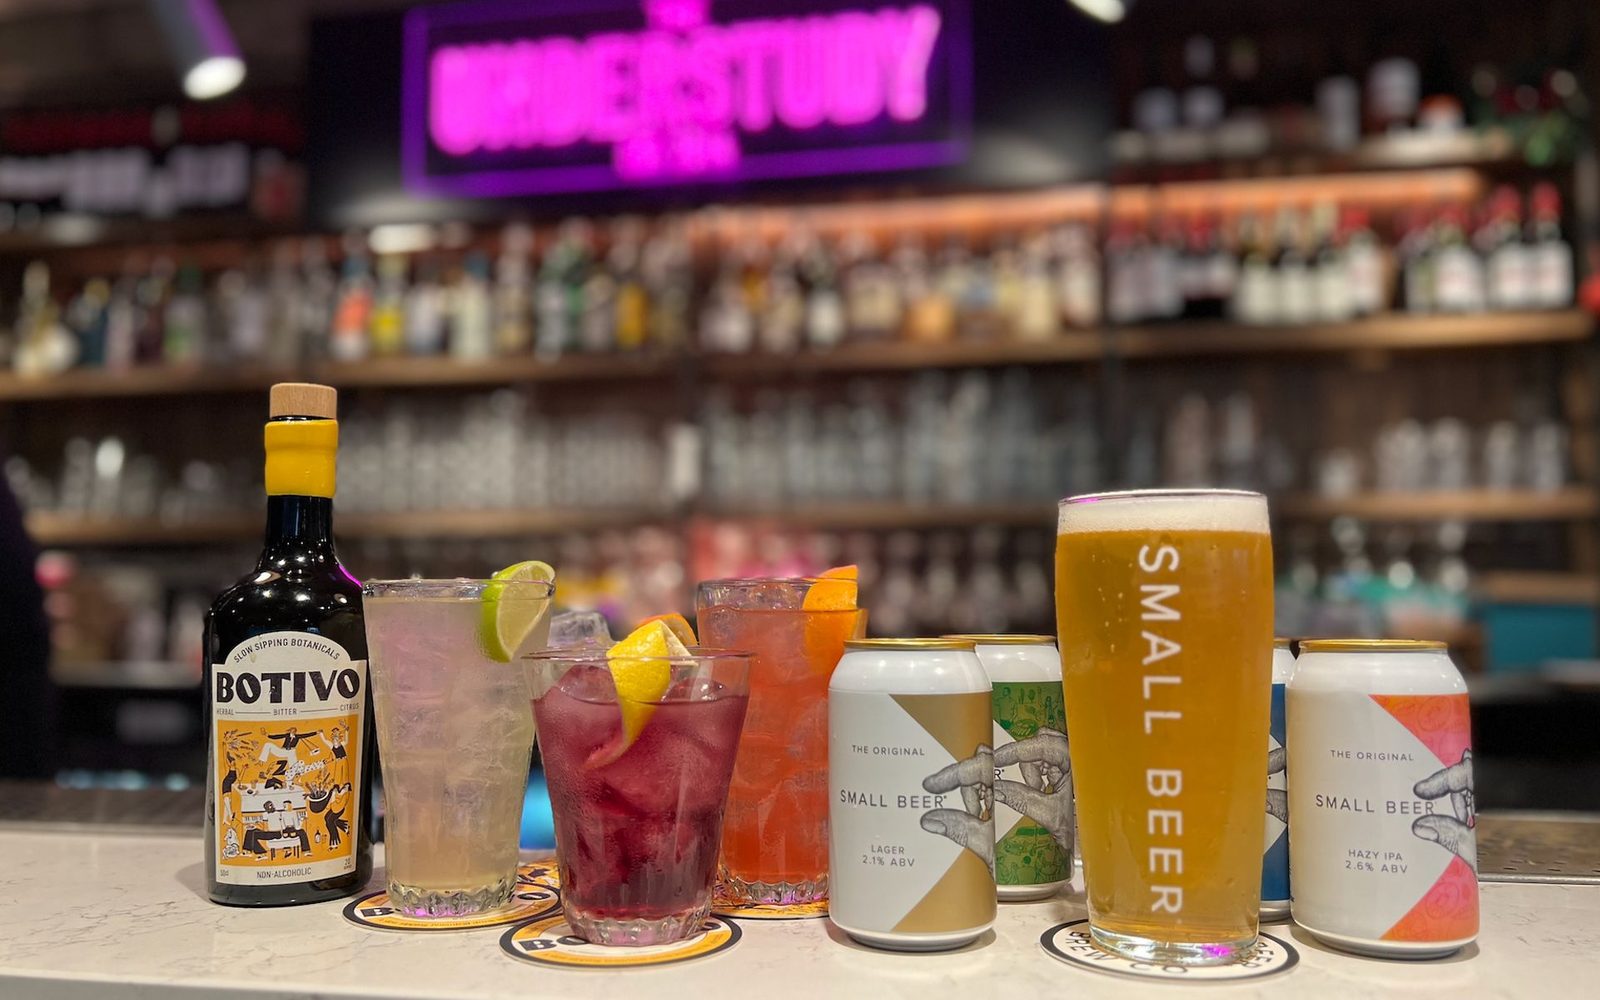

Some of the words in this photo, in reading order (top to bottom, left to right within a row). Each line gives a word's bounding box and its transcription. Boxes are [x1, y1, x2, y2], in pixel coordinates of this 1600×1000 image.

[1138, 544, 1183, 735] SMALL
[234, 645, 253, 663] SLOW
[254, 638, 289, 651] SIPPING
[291, 638, 341, 661] BOTANICALS
[216, 668, 361, 704] BOTIVO
[216, 708, 234, 716] HERBAL
[273, 708, 298, 716] BITTER
[340, 702, 360, 712] CITRUS
[852, 744, 869, 754] THE
[872, 746, 925, 756] ORIGINAL
[1330, 749, 1351, 759] THE
[1356, 751, 1415, 761] ORIGINAL
[840, 789, 888, 808] SMALL
[897, 795, 945, 809] BEER
[1315, 794, 1375, 813] SMALL
[1386, 800, 1435, 815] BEER
[1145, 769, 1184, 915] BEER
[870, 844, 905, 855] LAGER
[1348, 849, 1380, 861] HAZY
[1384, 851, 1403, 861] IPA
[862, 855, 885, 866] 2.1%
[890, 858, 915, 867] ABV
[1345, 860, 1374, 872] 2.6%
[1381, 864, 1408, 874] ABV
[256, 867, 312, 879] NON-ALCOHOLIC
[1129, 963, 1188, 974] CO
